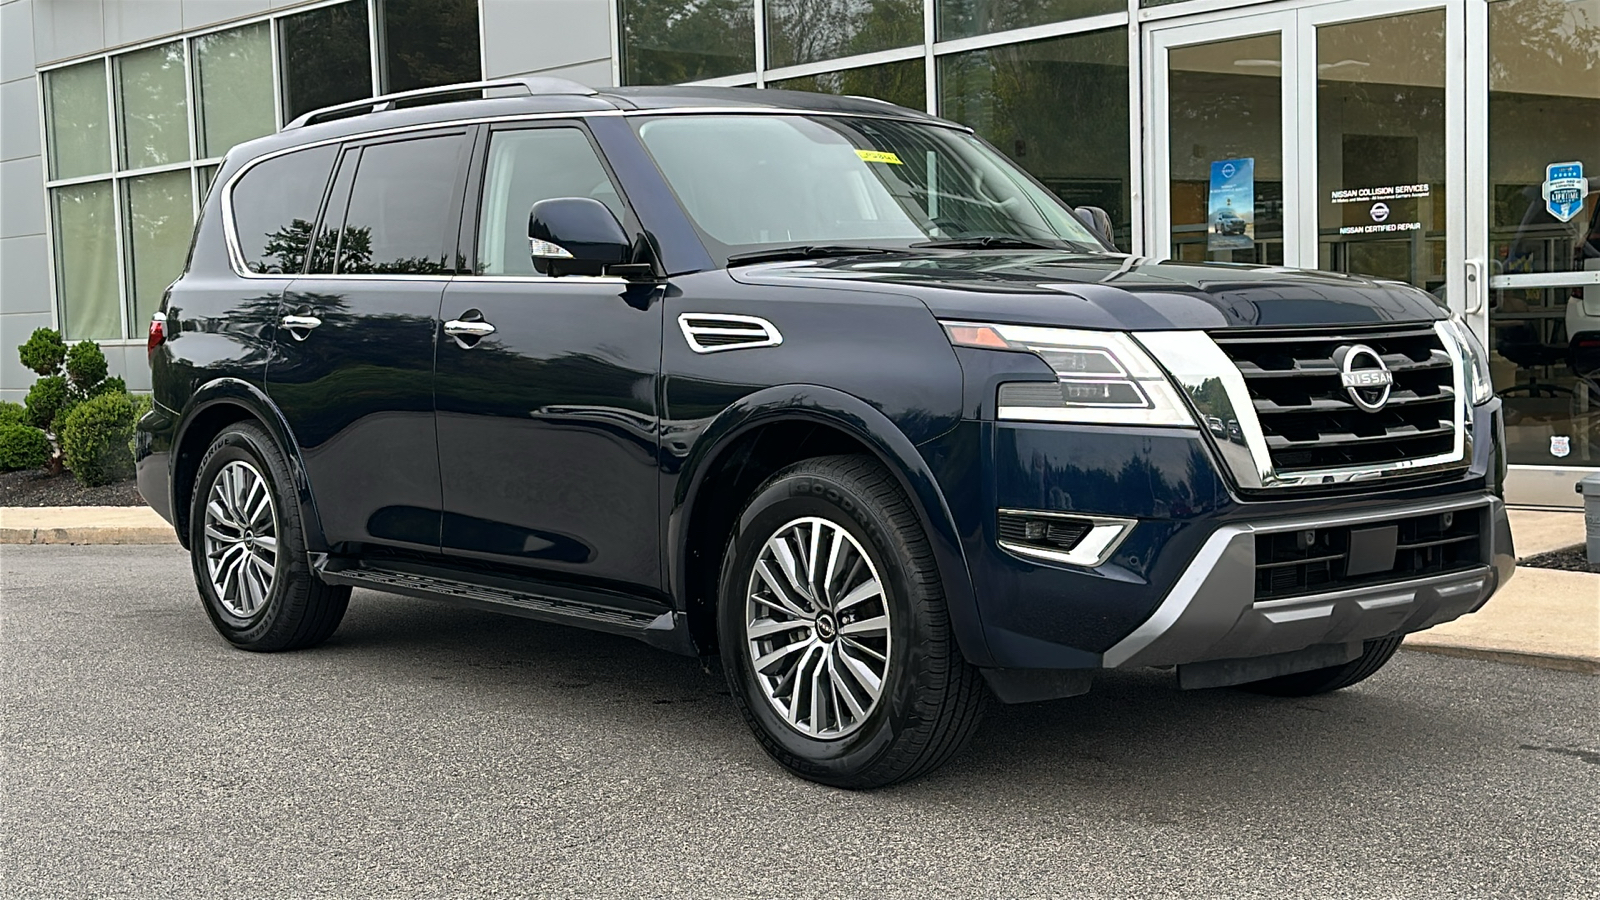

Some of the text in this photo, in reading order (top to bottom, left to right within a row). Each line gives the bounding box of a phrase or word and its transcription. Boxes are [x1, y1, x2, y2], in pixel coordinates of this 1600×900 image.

[1331, 183, 1429, 199] NISSAN COLLISION SERVICES
[1339, 222, 1421, 234] NISSAN CERTIFIED REPAIR
[1343, 372, 1393, 386] NISSAN
